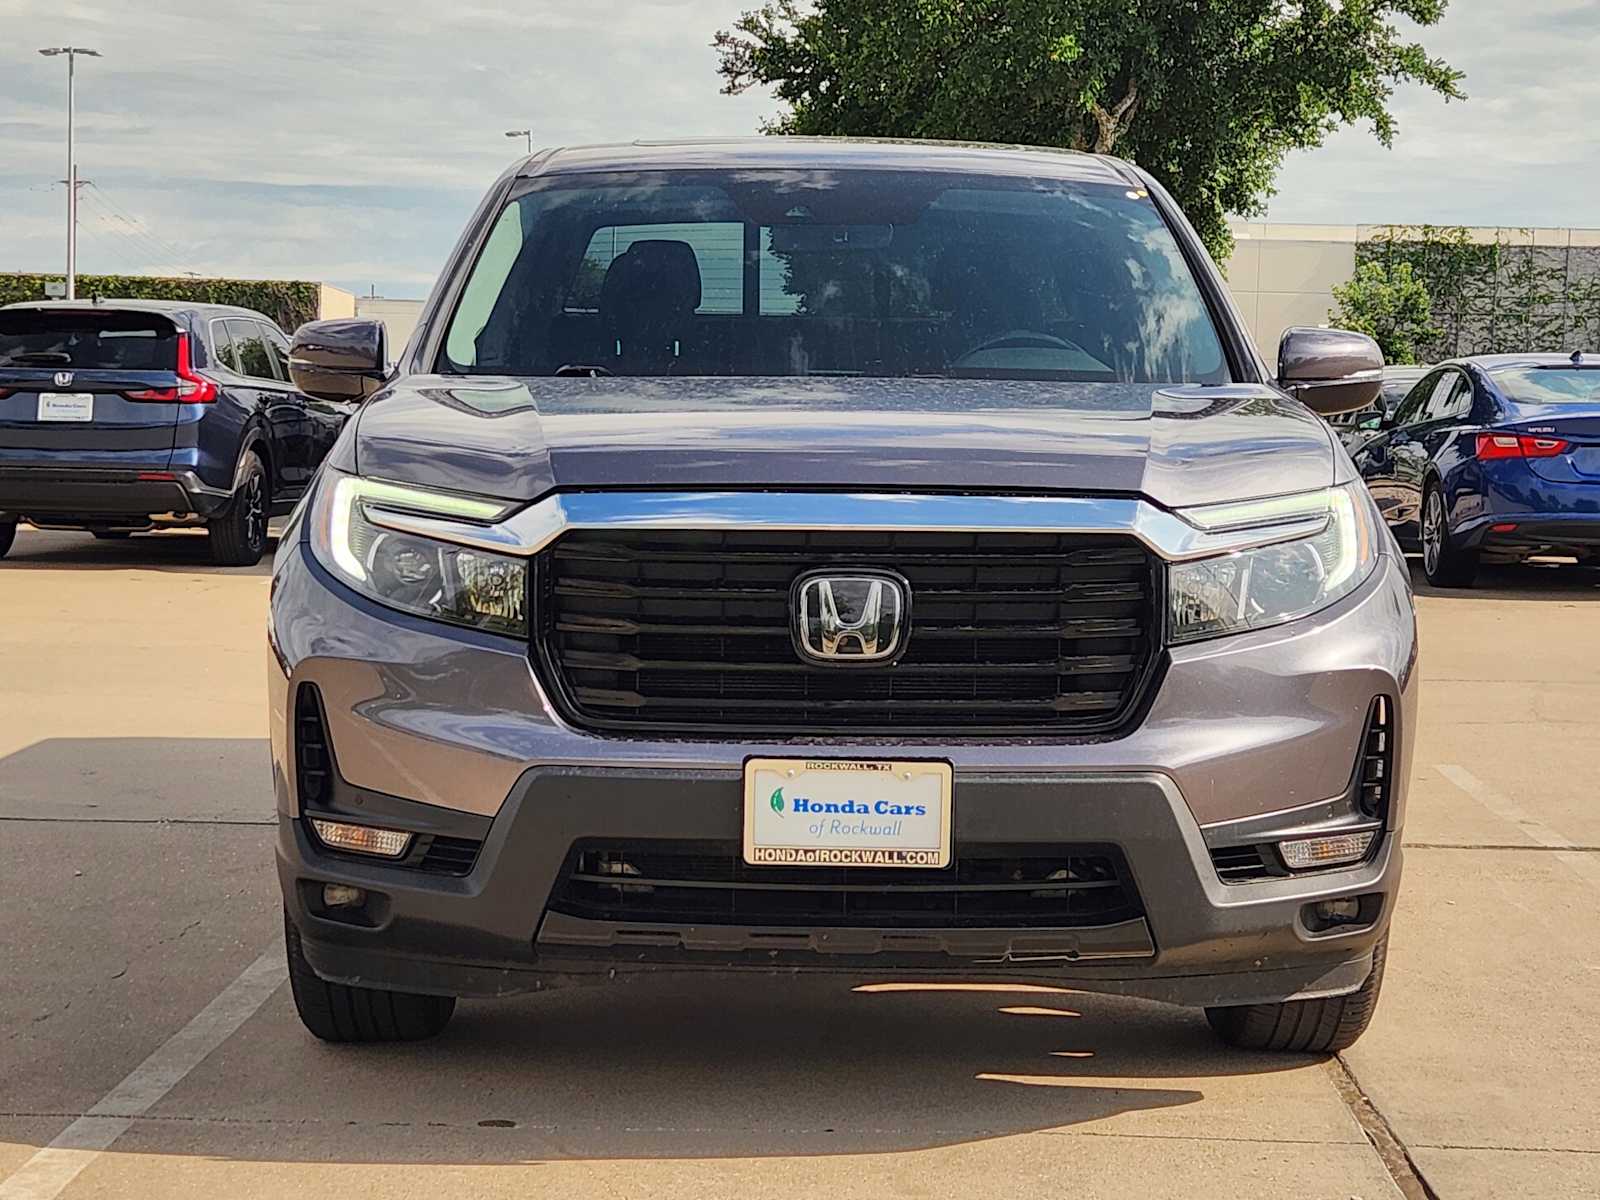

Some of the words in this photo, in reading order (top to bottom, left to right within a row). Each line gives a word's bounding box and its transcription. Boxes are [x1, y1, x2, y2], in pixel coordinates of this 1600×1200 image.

[876, 764, 891, 772] TX
[792, 798, 870, 815] Honda
[874, 800, 927, 816] Cars
[809, 818, 827, 839] of
[830, 819, 903, 837] Rockwall
